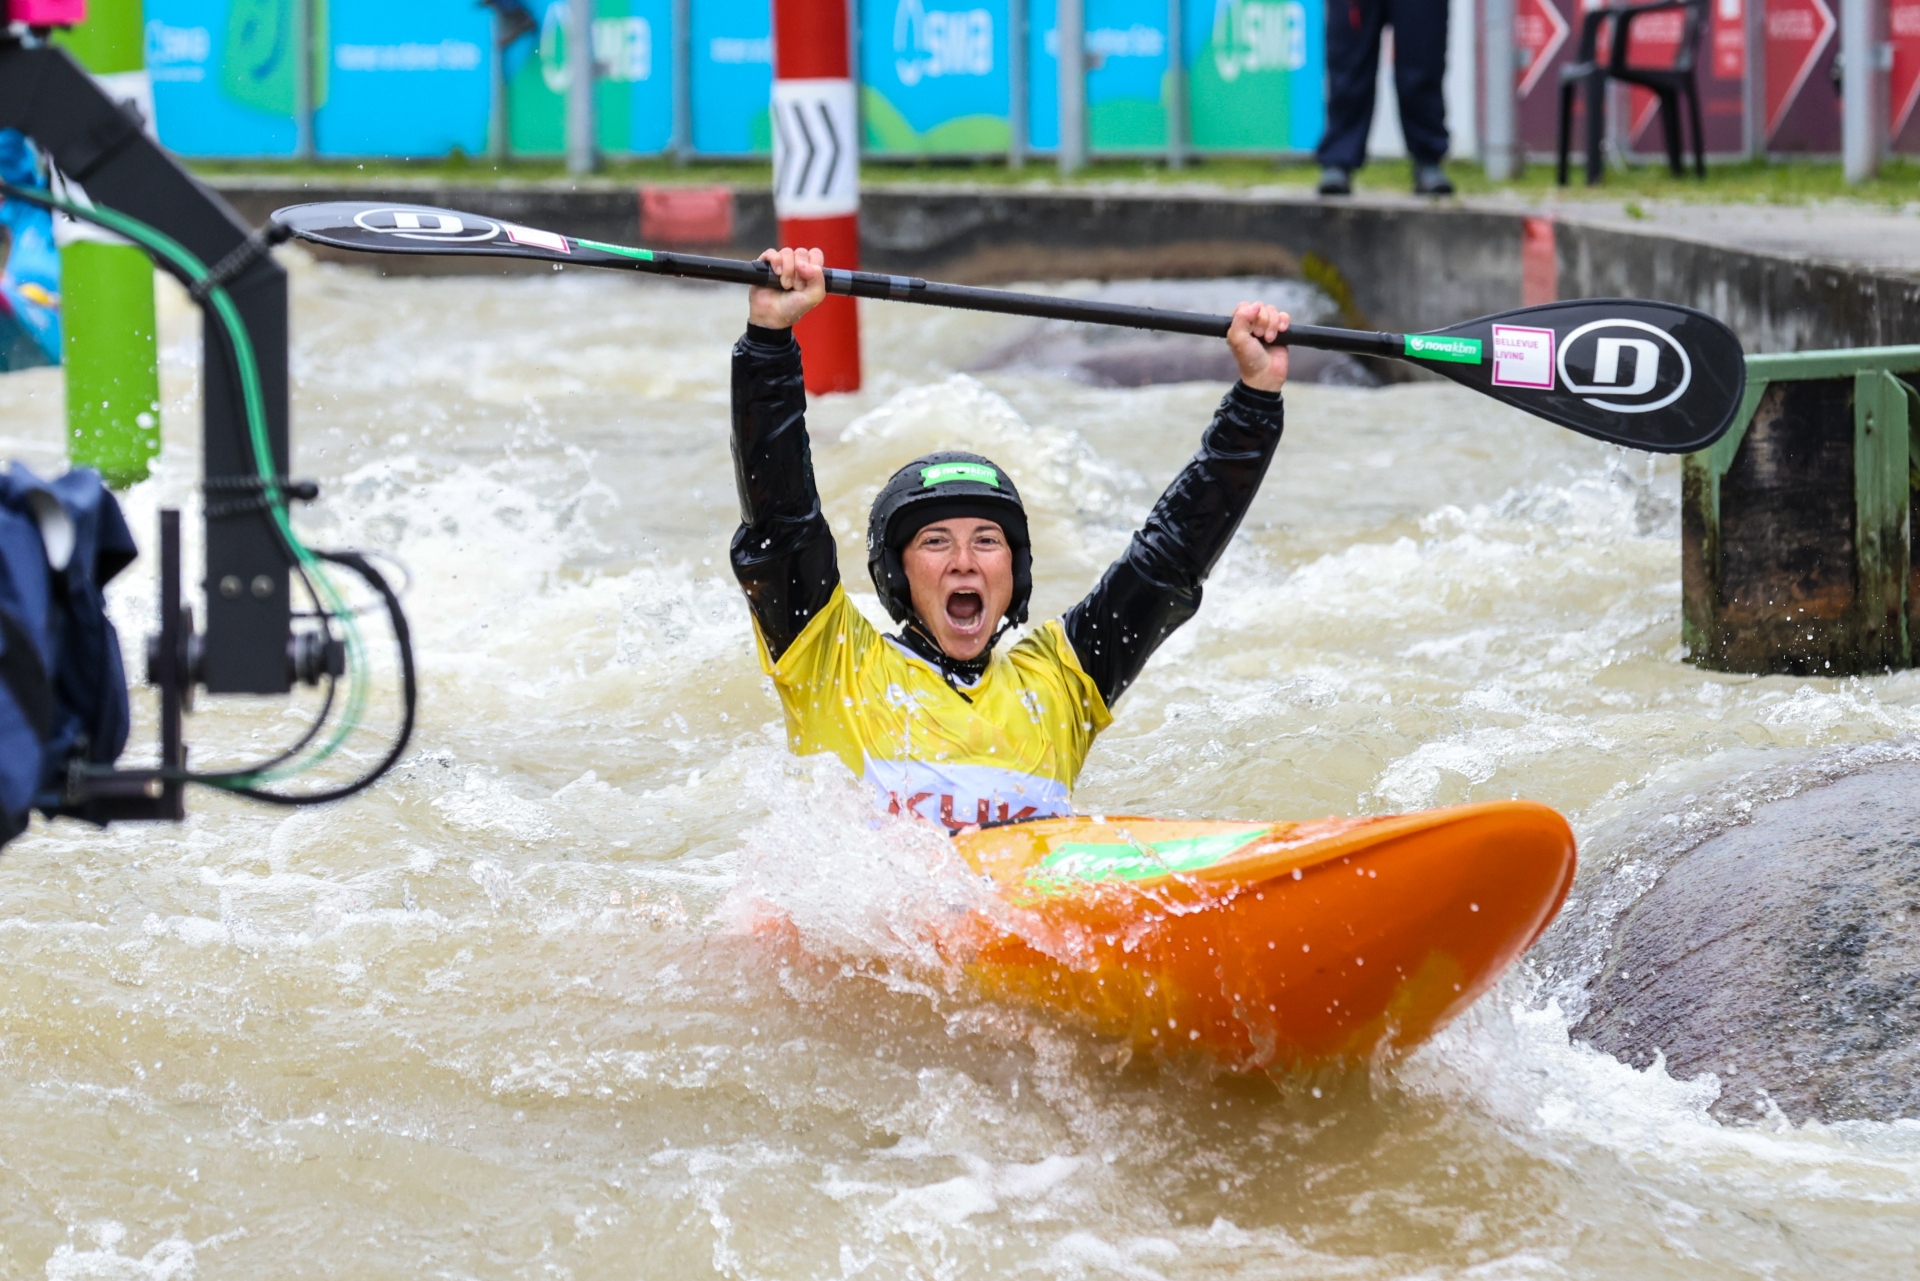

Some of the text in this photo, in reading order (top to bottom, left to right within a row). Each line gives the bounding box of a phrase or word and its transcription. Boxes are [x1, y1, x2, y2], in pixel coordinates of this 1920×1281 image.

[1424, 342, 1476, 354] novakbm
[1495, 337, 1539, 349] BELLEVUE
[1495, 351, 1525, 361] LIVING
[888, 791, 1062, 831] KUK
